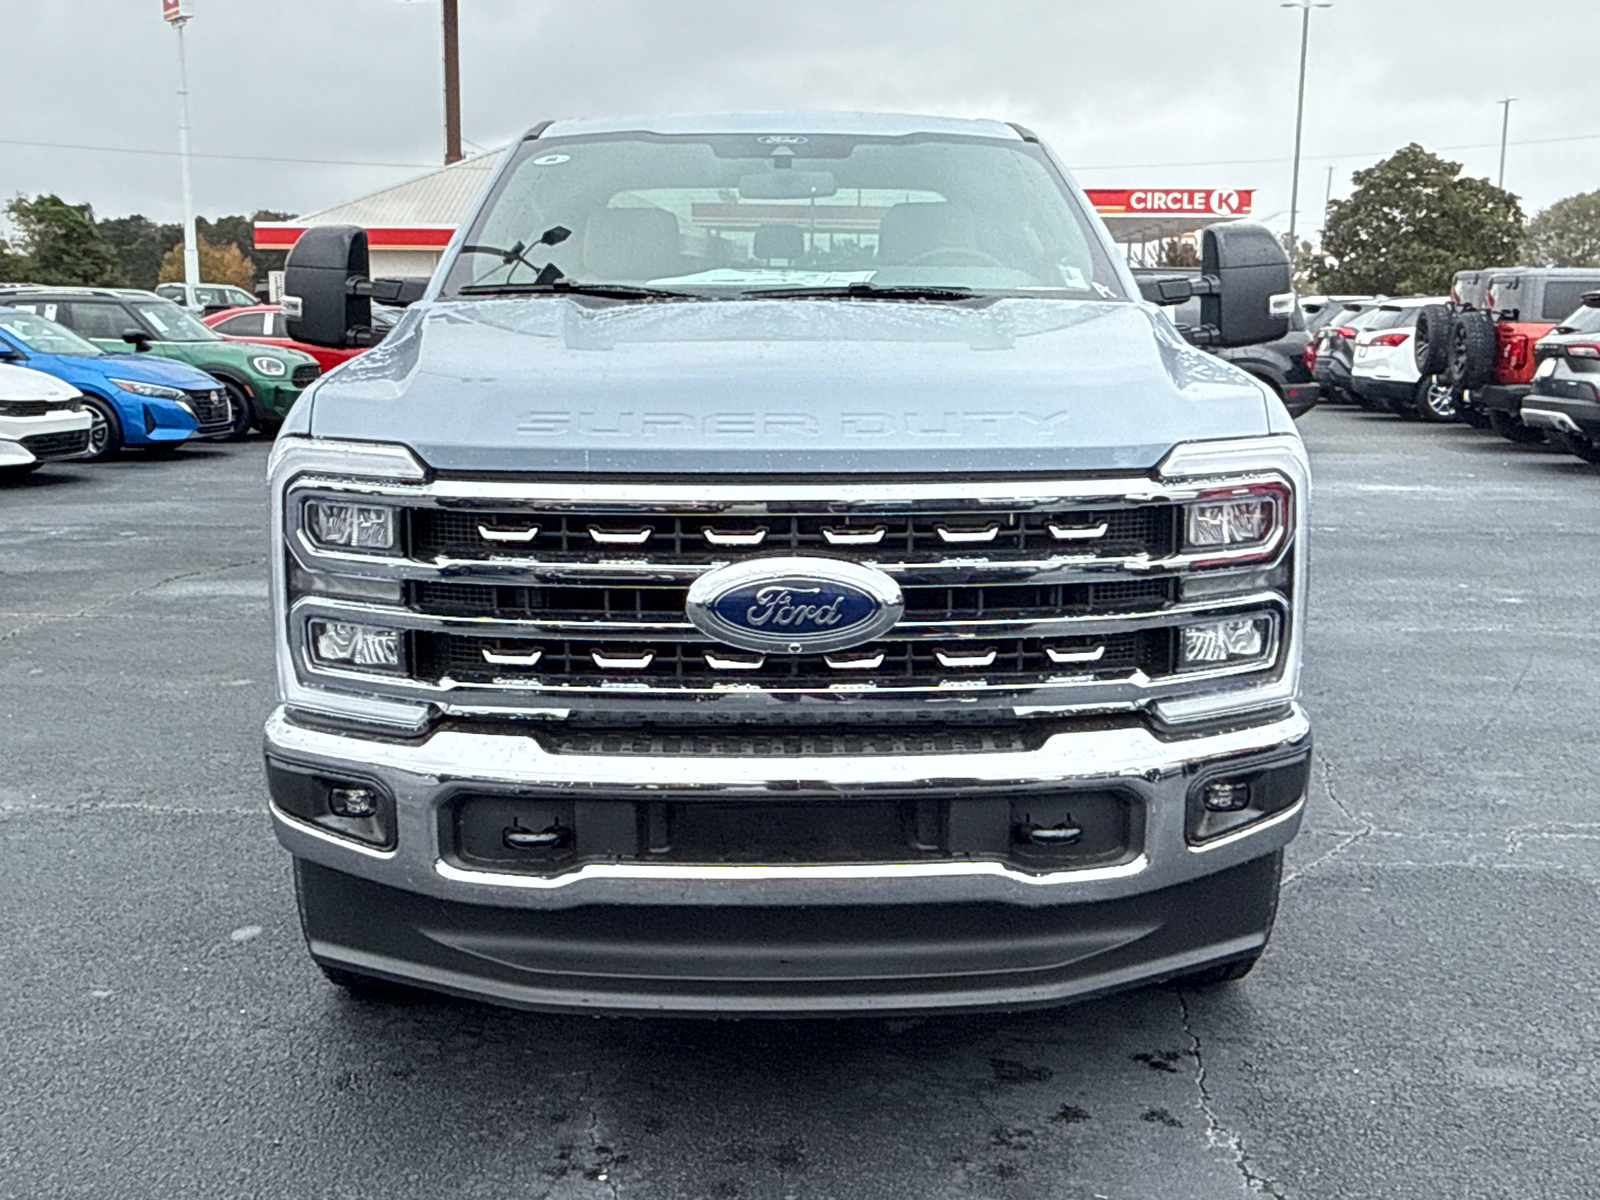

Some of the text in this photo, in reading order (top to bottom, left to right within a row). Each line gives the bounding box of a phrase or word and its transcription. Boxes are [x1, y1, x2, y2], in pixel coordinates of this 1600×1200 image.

[1129, 191, 1237, 214] CIRCLE K
[516, 410, 1069, 437] SUPER DUTY
[746, 586, 845, 626] Ford
